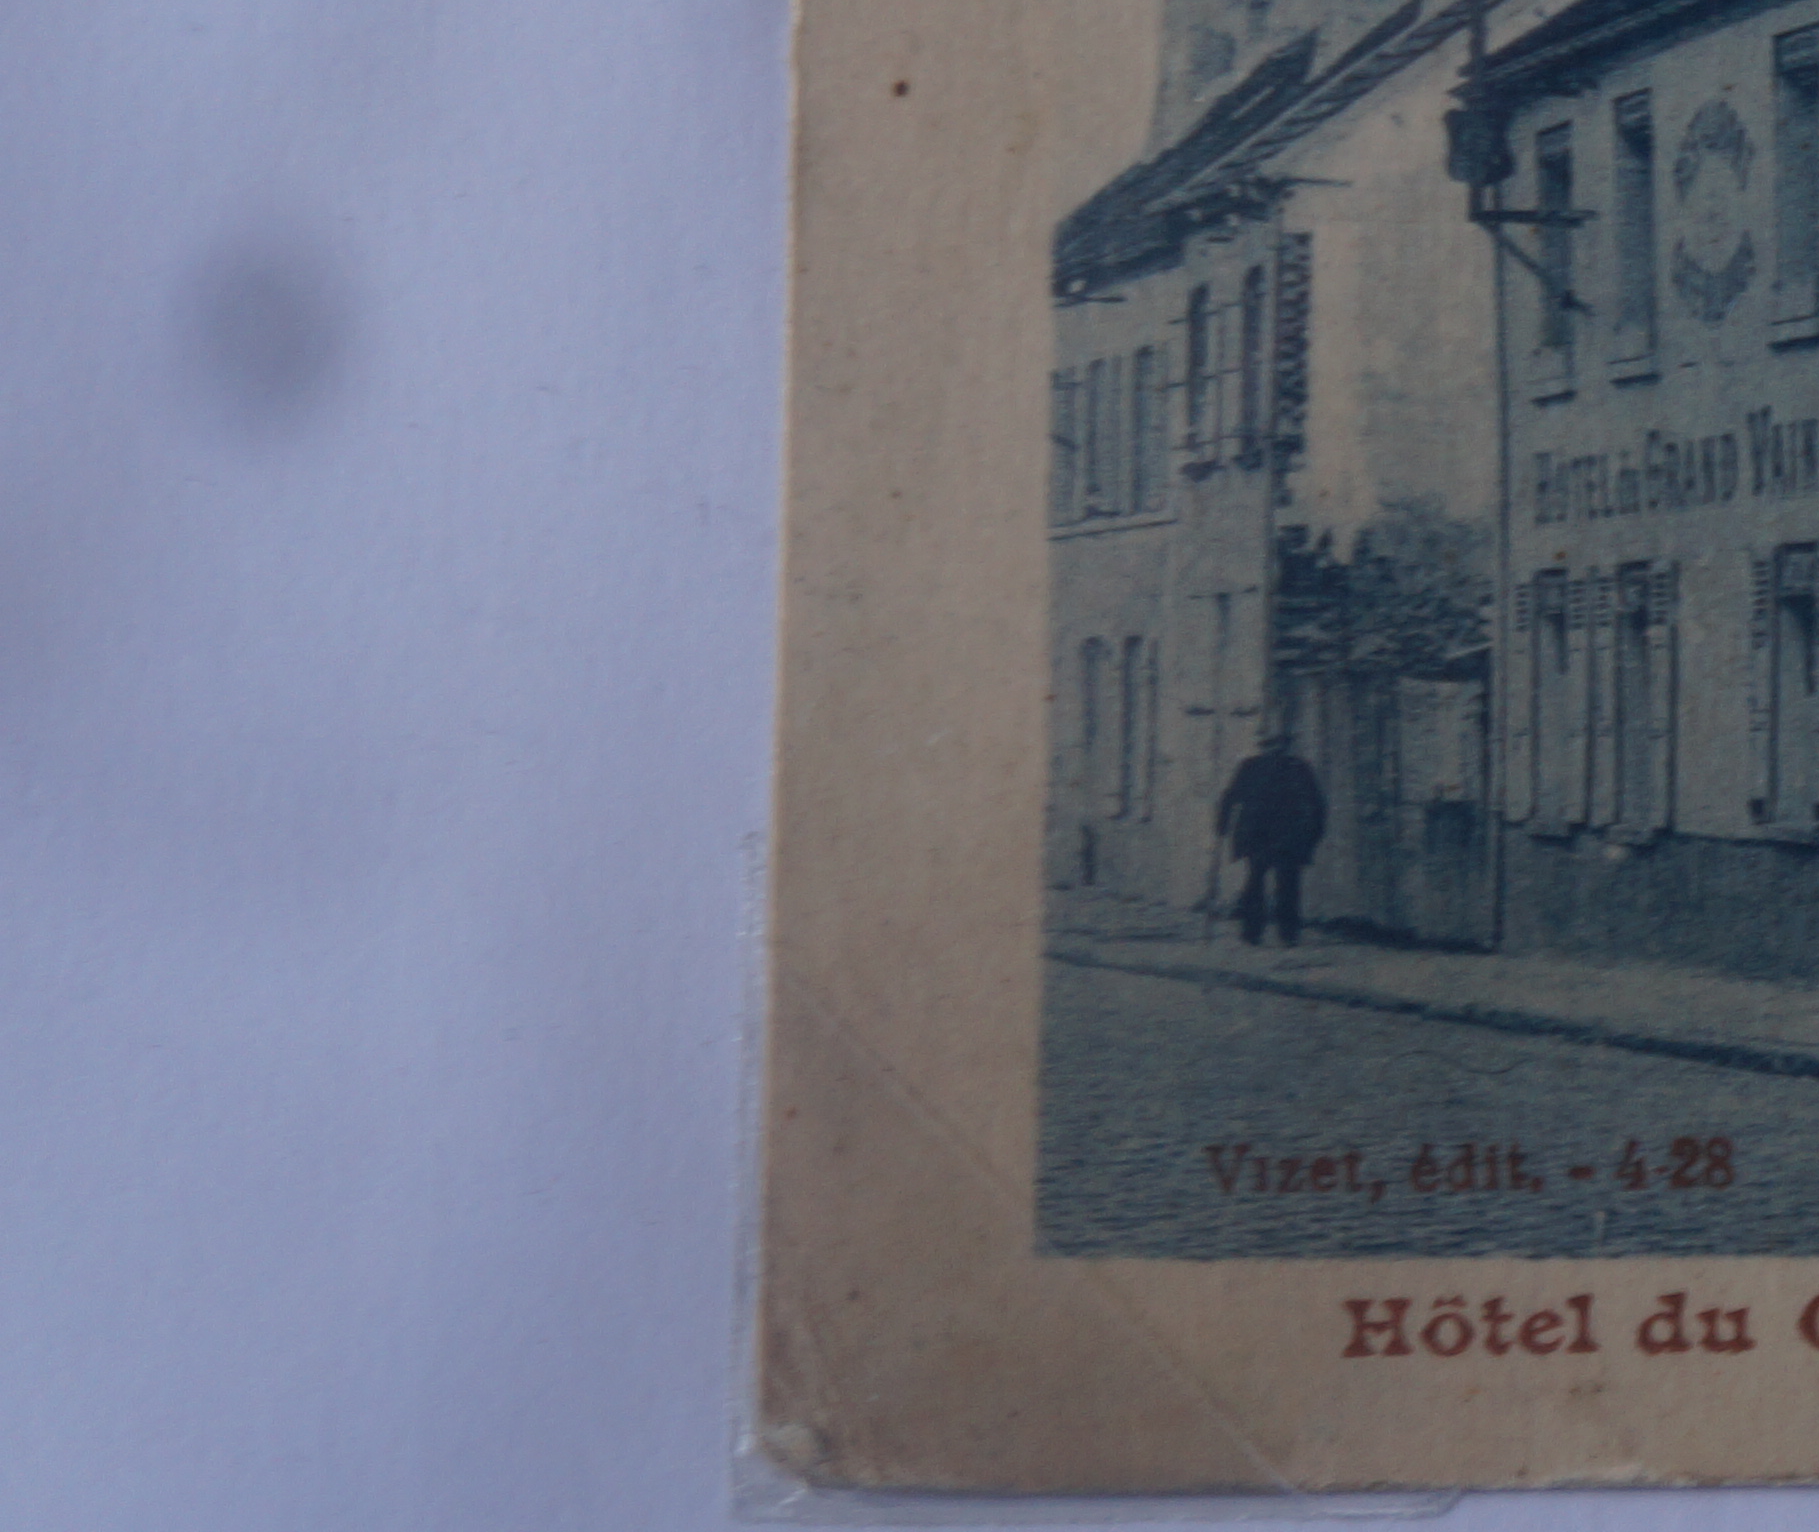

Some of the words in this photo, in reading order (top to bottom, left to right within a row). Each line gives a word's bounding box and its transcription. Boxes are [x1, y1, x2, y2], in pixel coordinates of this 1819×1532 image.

[1410, 1140, 1546, 1194] édit.
[1342, 1294, 1600, 1358] Hôtel
[1635, 1290, 1756, 1355] du
